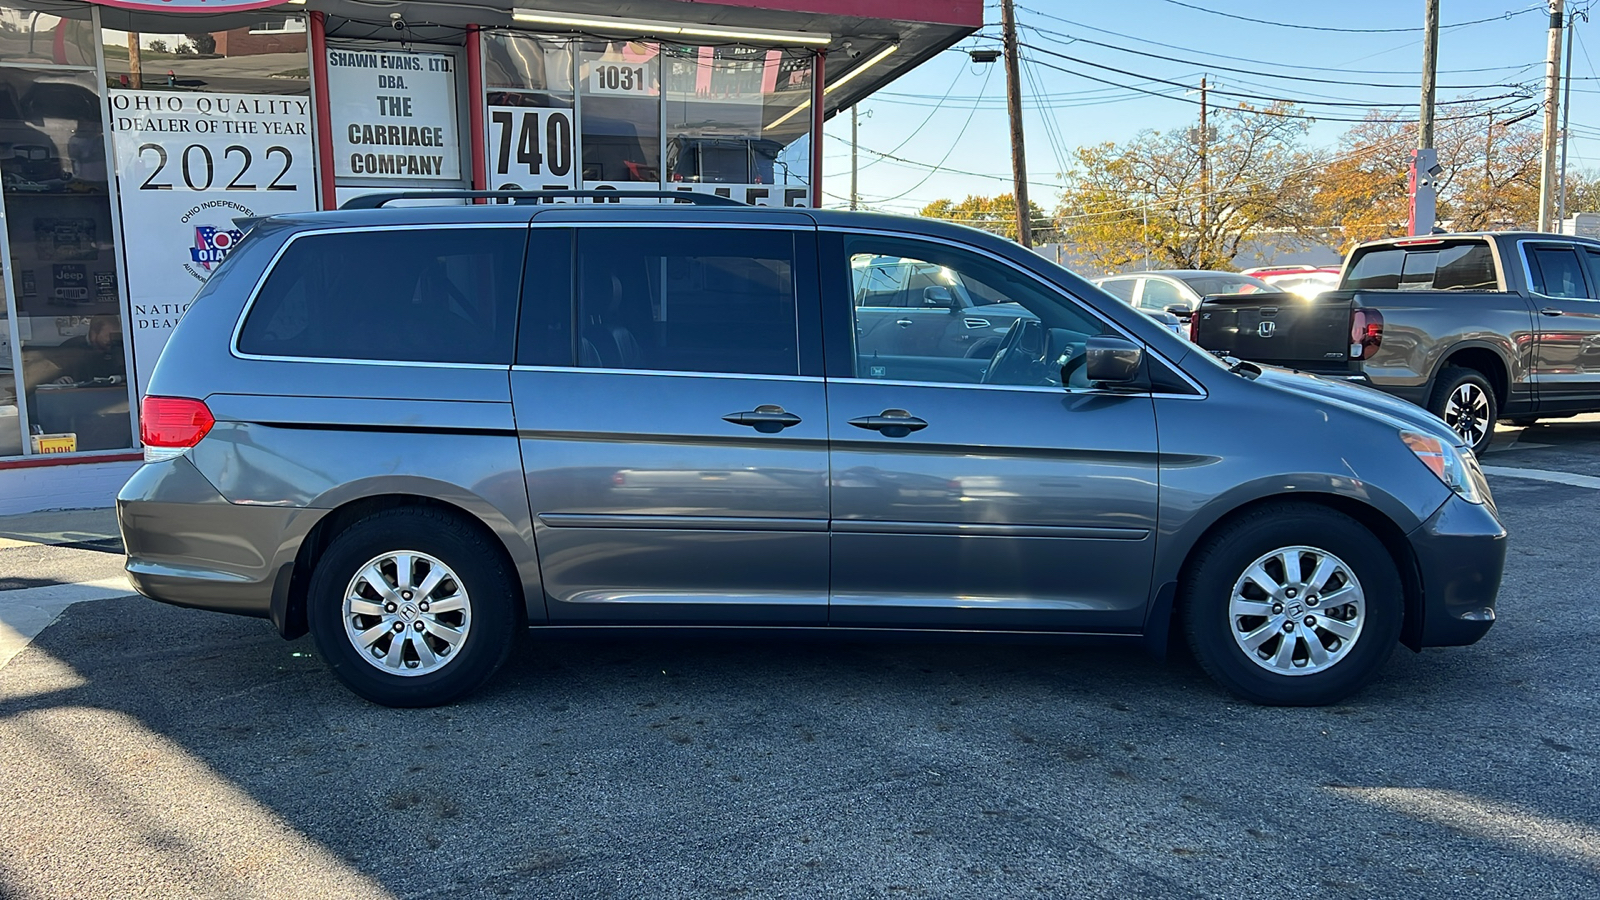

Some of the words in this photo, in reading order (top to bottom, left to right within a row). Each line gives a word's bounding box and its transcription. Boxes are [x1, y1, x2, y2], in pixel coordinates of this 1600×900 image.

[330, 52, 378, 69] SHAWN
[380, 55, 424, 71] EVANS.
[428, 58, 453, 73] LTD.
[378, 74, 408, 90] DBA.
[595, 65, 644, 91] 1031
[113, 94, 183, 112] OHIO
[196, 97, 308, 116] QUALITY
[377, 95, 413, 117] THE
[118, 117, 192, 133] DEALER
[195, 119, 219, 133] OF
[222, 120, 258, 134] THE
[261, 121, 307, 135] YEAR
[348, 123, 444, 147] CARRIAGE
[492, 110, 571, 177] 740
[138, 143, 298, 191] 2022
[350, 153, 444, 176] COMPANY
[181, 206, 200, 224] OHIO
[56, 270, 84, 281] Jeep
